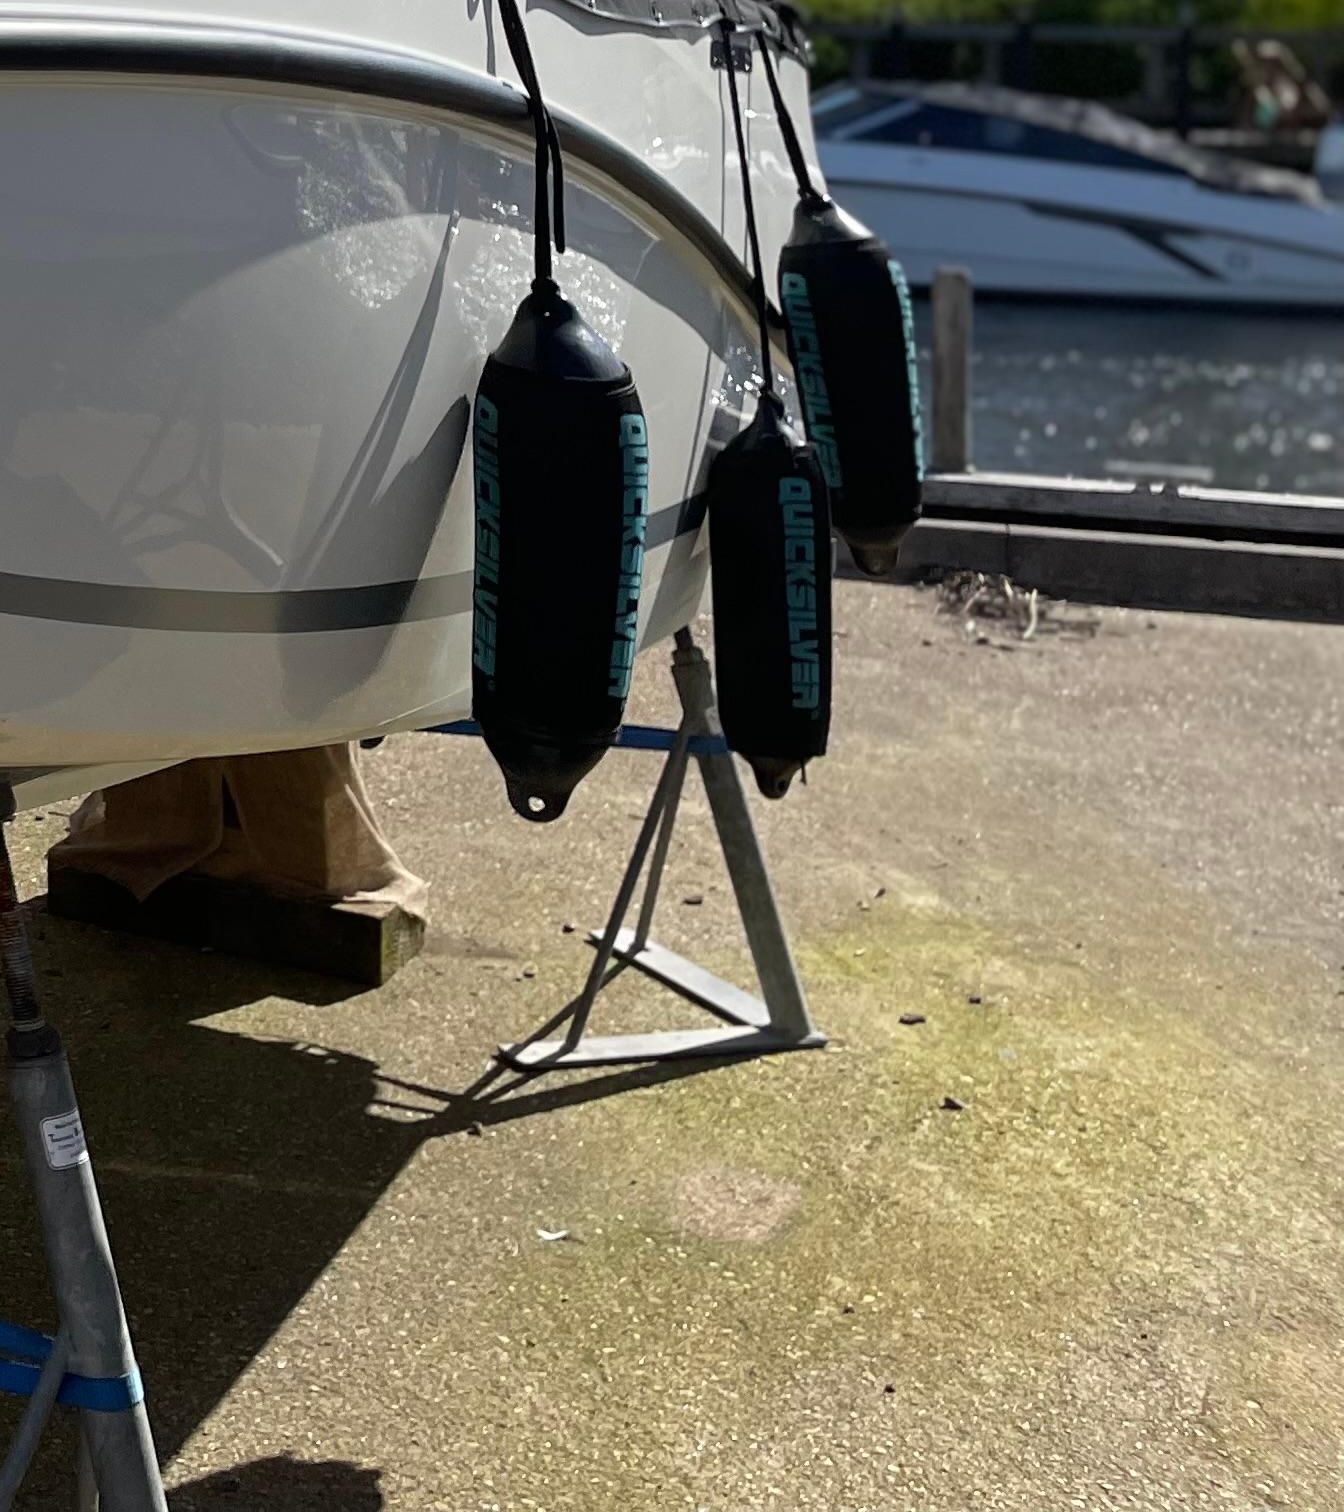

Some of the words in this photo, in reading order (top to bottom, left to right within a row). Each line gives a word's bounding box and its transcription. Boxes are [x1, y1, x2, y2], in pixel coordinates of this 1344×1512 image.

[781, 272, 843, 488] QUICKSILVER
[473, 393, 501, 676] QUICKSILVER
[608, 414, 649, 697] QUICKSILVER
[779, 477, 820, 708] QUICKSILVER
